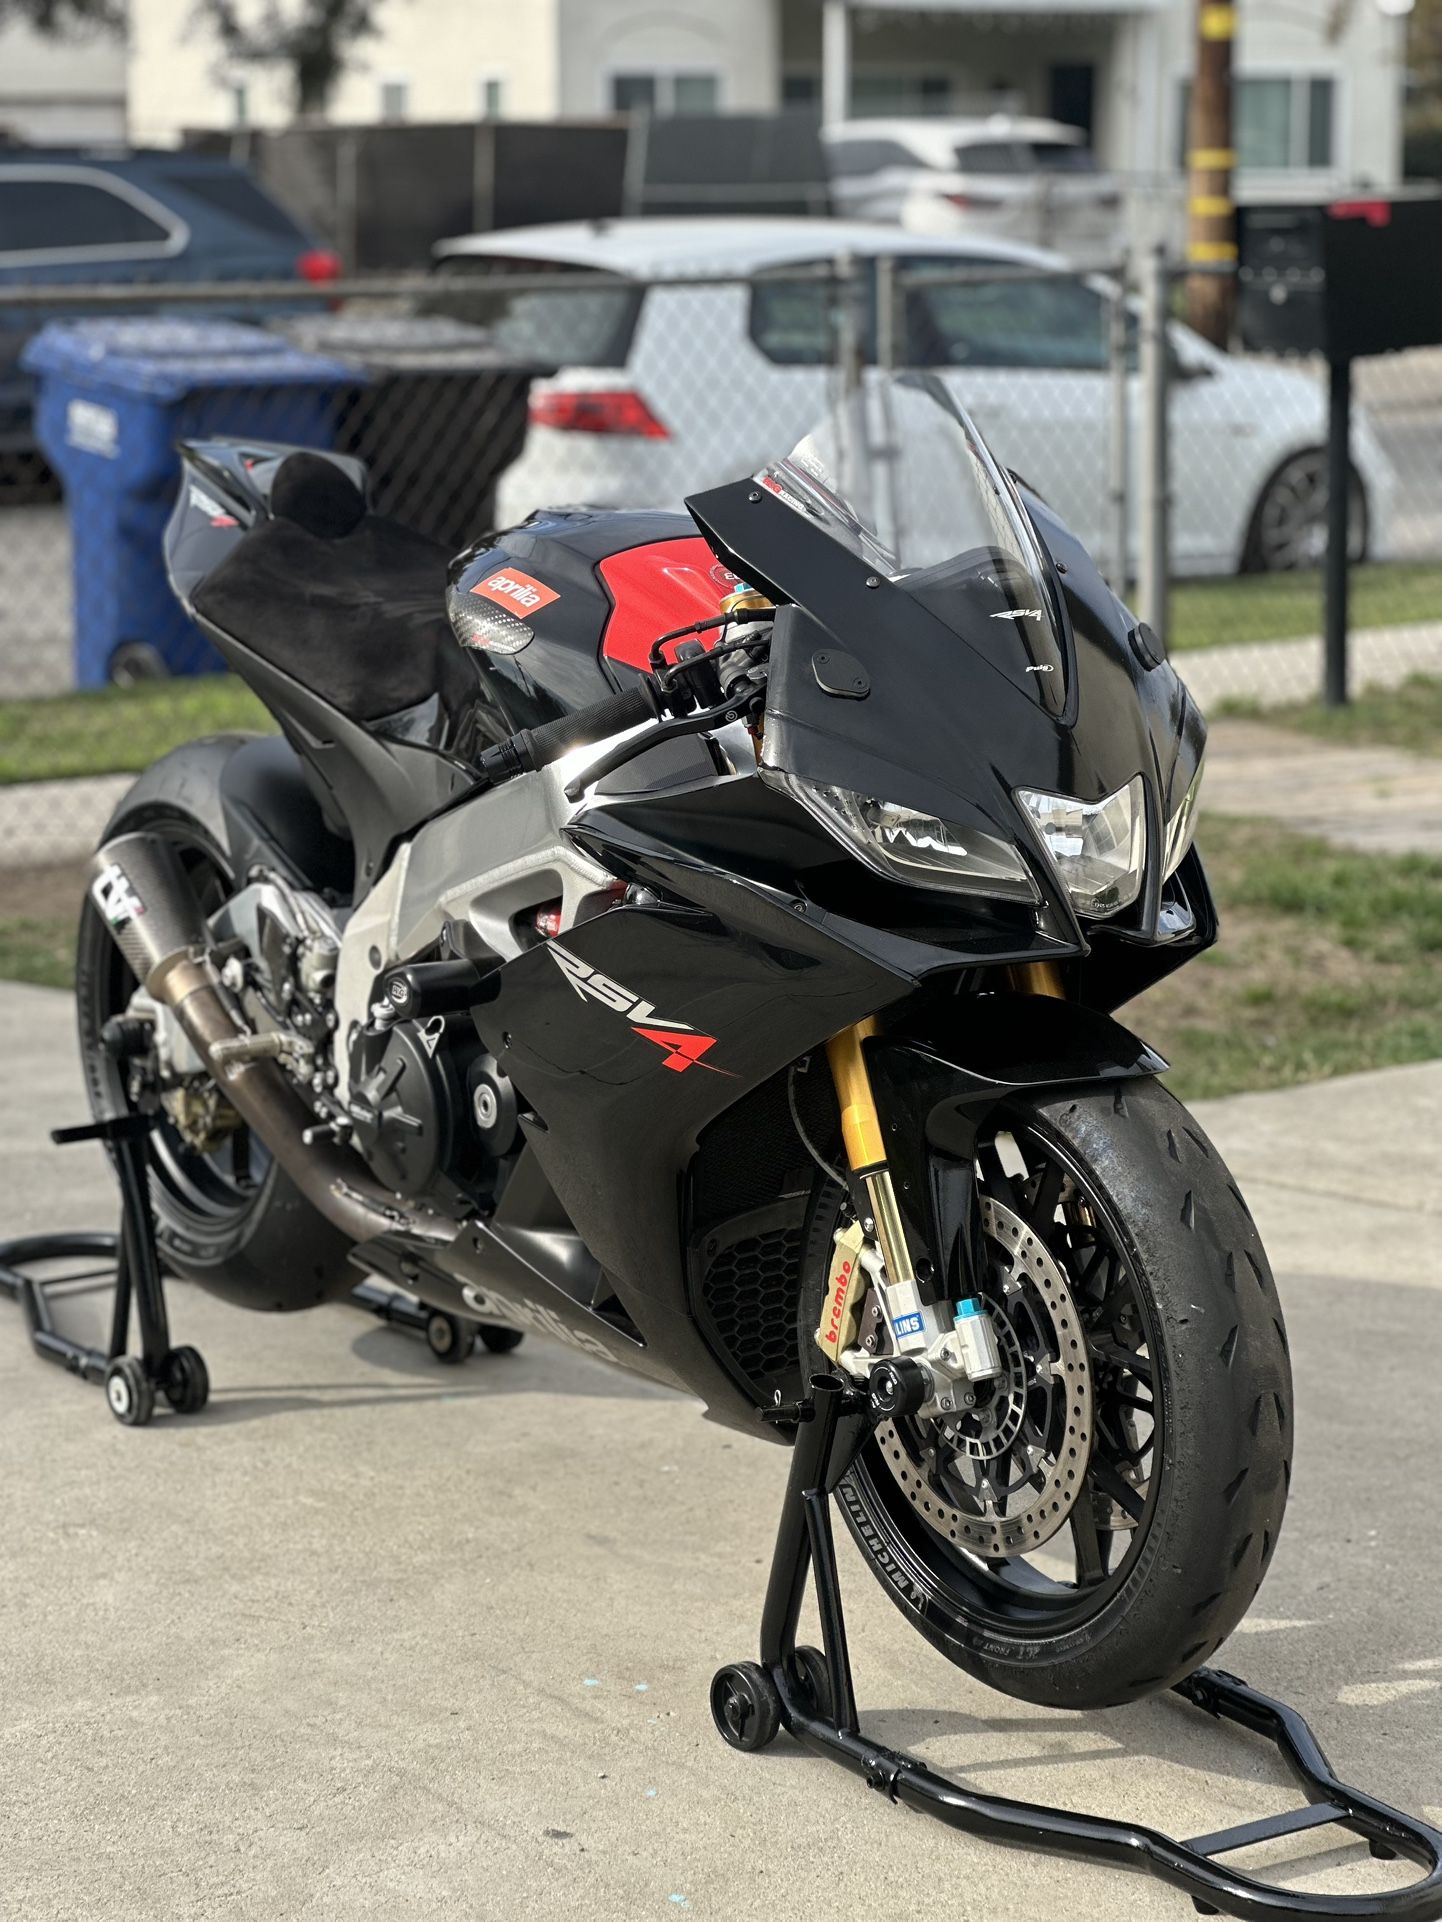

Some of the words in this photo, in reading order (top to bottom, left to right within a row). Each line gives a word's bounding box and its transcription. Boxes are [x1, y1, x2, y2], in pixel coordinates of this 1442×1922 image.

[487, 576, 541, 608] aprilia
[825, 1260, 851, 1344] brembo
[842, 1487, 910, 1590] MICHELIN
